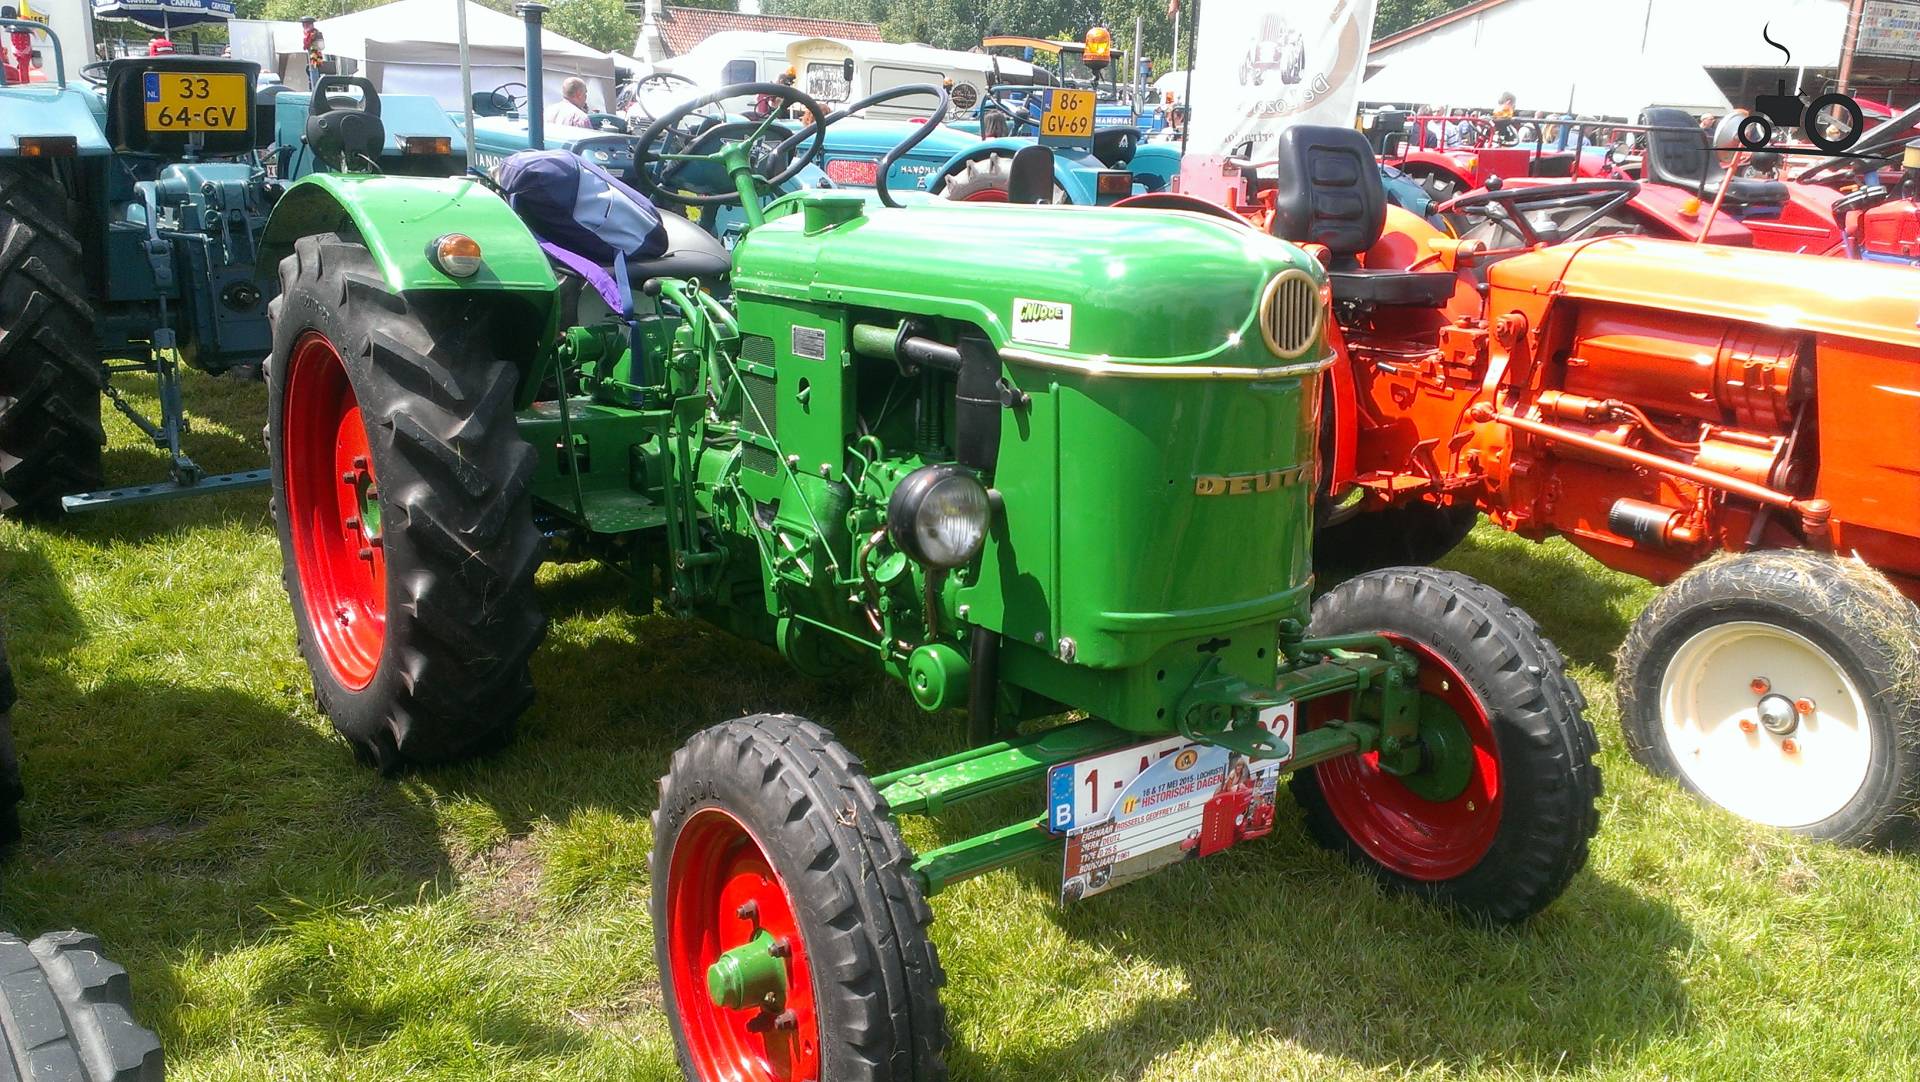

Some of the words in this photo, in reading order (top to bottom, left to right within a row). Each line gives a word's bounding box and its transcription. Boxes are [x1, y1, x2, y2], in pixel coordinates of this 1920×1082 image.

[211, 2, 231, 12] CAMPARI
[147, 90, 159, 98] NL
[179, 78, 210, 99] 33
[1060, 93, 1083, 110] 86-
[159, 106, 237, 127] 64-GV
[1048, 115, 1088, 133] GV-69
[1141, 783, 1196, 808] HISTORISCHE
[1196, 774, 1224, 791] DAGEN
[1166, 778, 1179, 791] MEI
[1179, 773, 1194, 787] 2015
[1056, 803, 1073, 826] B
[1102, 834, 1121, 846] DEUTZ
